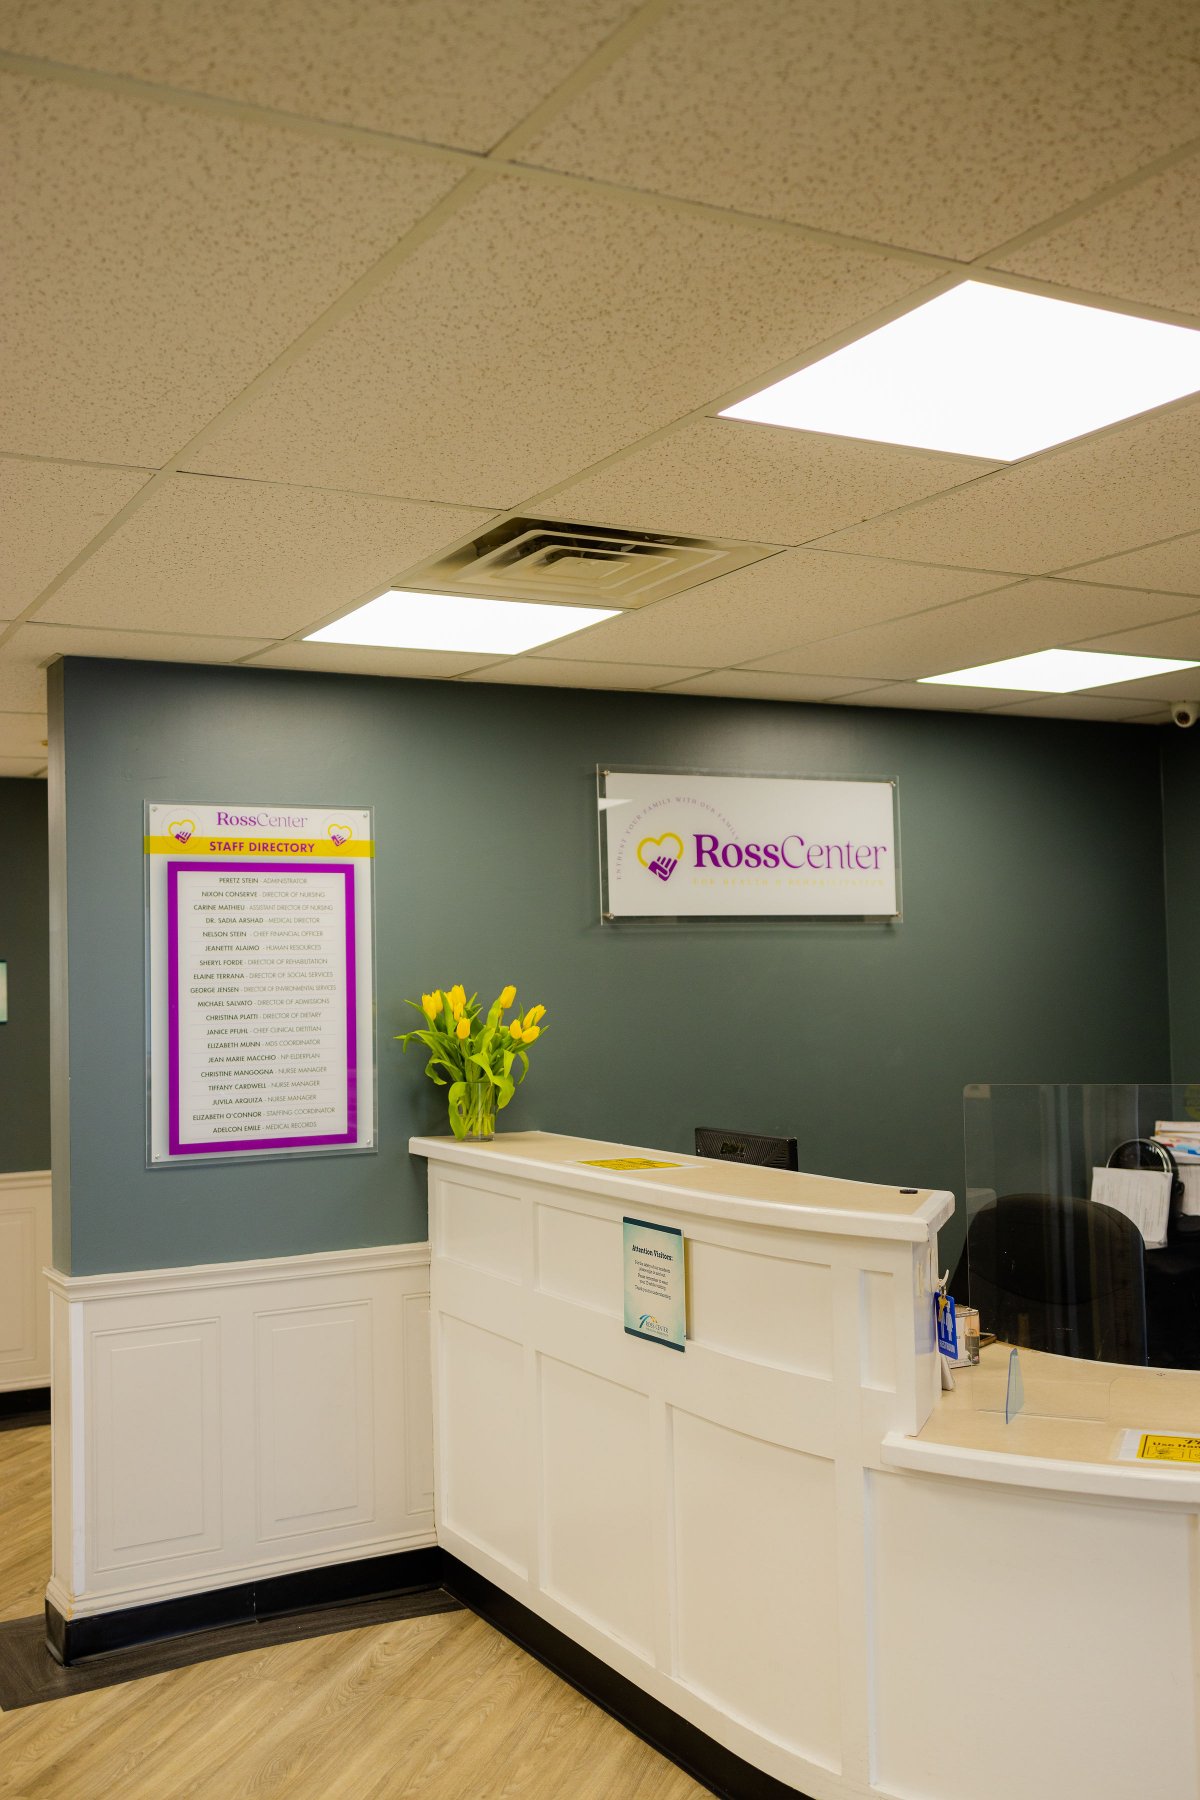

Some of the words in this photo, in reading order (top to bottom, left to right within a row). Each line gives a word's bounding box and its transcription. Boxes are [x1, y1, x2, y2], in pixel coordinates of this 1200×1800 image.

[643, 798, 671, 814] FAMILY
[675, 796, 697, 804] WITH
[700, 802, 715, 813] OUR
[217, 811, 308, 828] RossCenter
[209, 841, 244, 852] STAFF
[249, 842, 315, 853] DIRECTORY
[693, 834, 887, 869] RossCenter
[201, 1070, 232, 1078] CHRISTINE
[212, 1098, 233, 1106] JUVILA
[287, 1094, 317, 1102] MANAGER
[226, 1111, 262, 1119] O'CONNOR
[266, 1109, 292, 1117] STAFFING
[293, 1107, 335, 1115] COORDINATOR
[212, 1126, 243, 1134] ADELCON
[265, 1123, 289, 1131] MEDICAL
[291, 1121, 317, 1129] RECORDS
[632, 1244, 653, 1256] Attention
[653, 1250, 674, 1261] Visitors:
